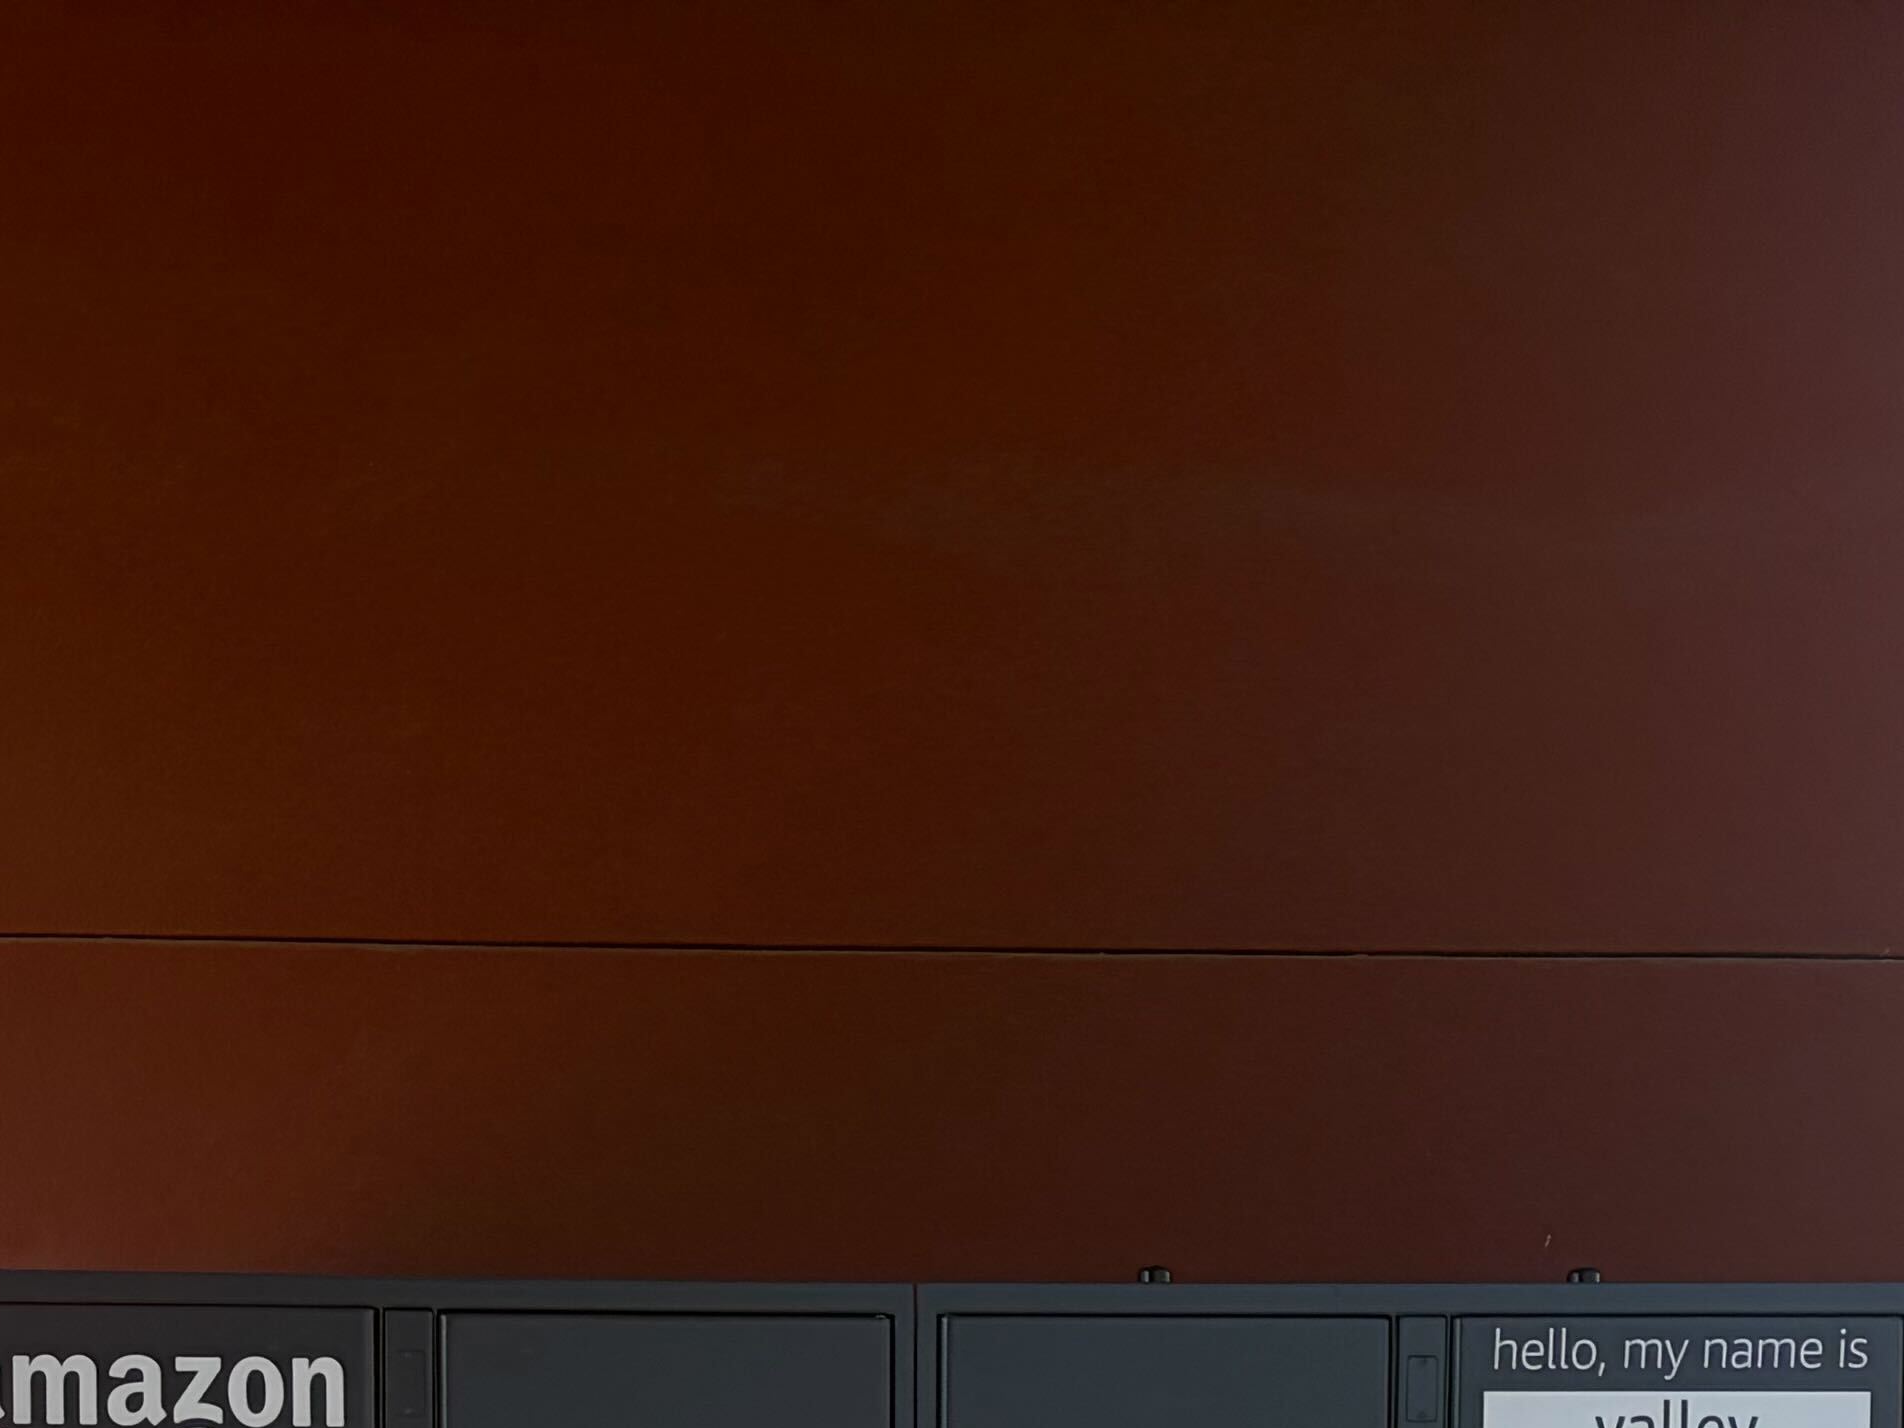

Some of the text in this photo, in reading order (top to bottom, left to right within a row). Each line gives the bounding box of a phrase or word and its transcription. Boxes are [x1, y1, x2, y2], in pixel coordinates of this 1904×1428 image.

[1493, 1327, 1869, 1381] hello, my name is
